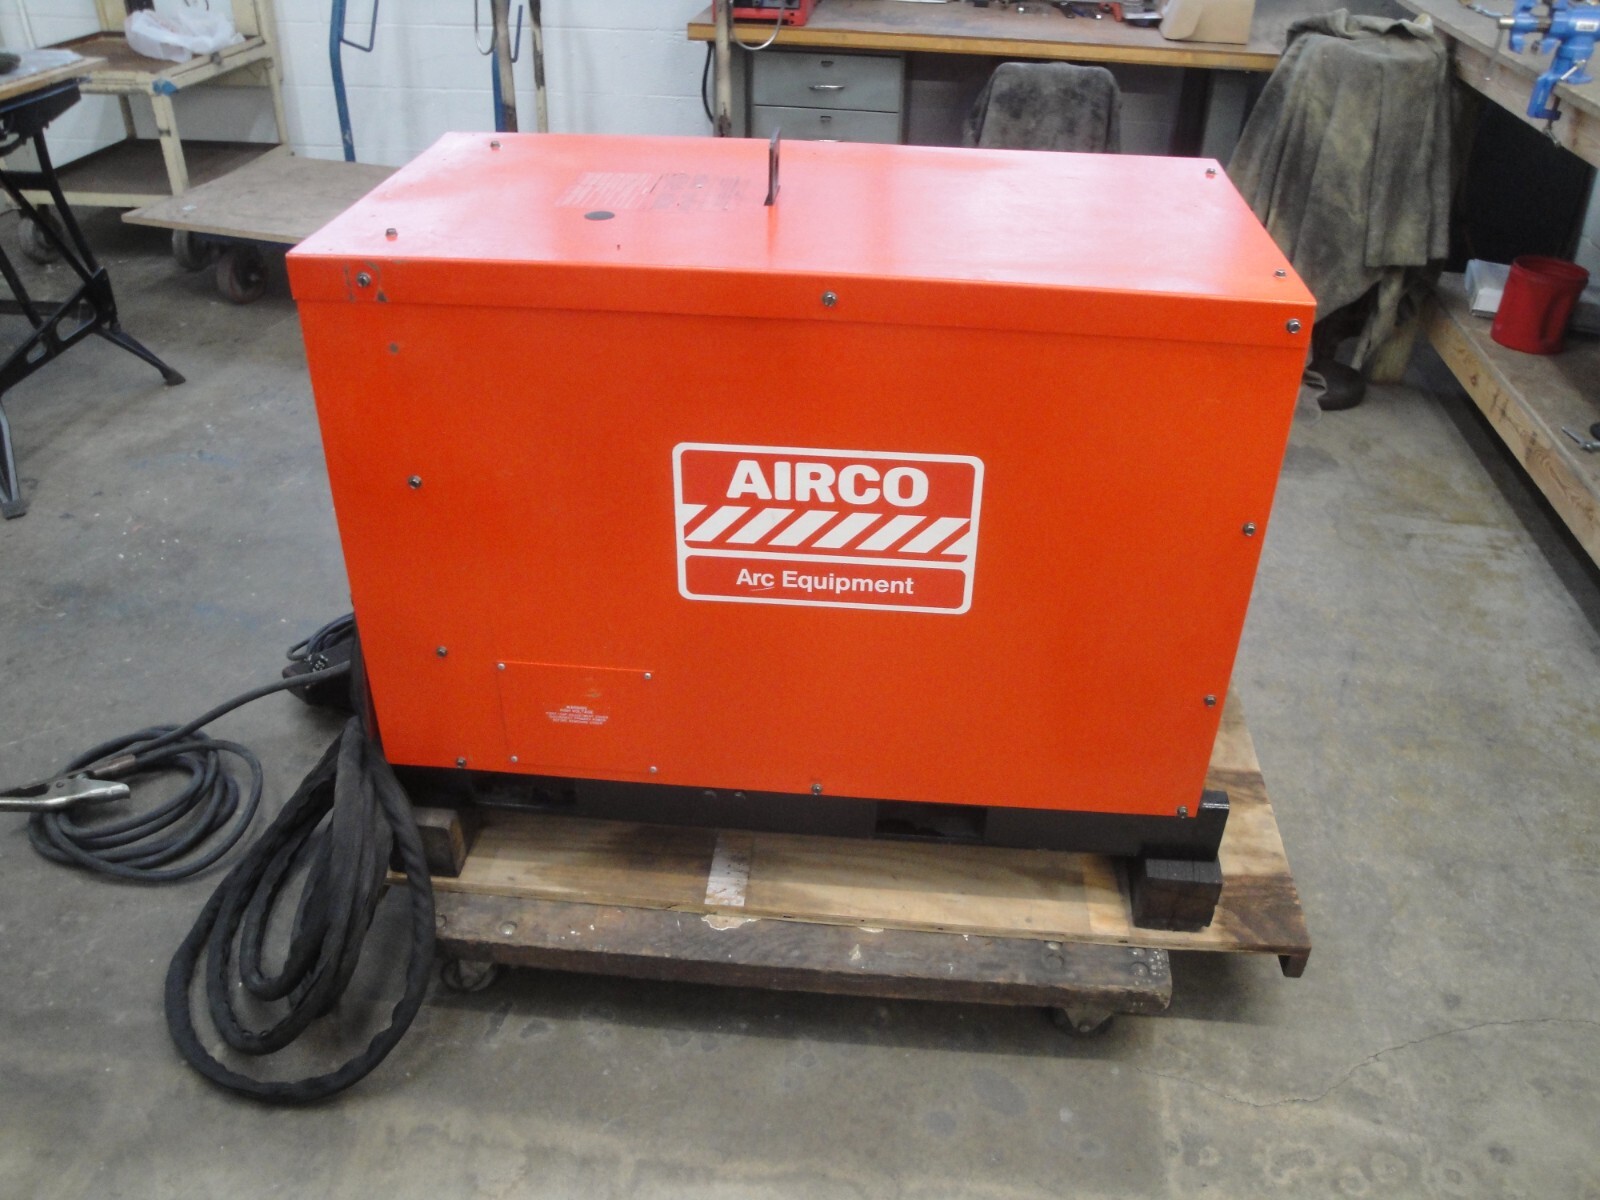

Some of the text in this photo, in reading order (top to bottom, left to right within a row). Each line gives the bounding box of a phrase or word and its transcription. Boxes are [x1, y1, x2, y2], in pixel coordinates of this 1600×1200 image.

[726, 460, 929, 507] AIRCO
[736, 568, 914, 595] Arc Equipment
